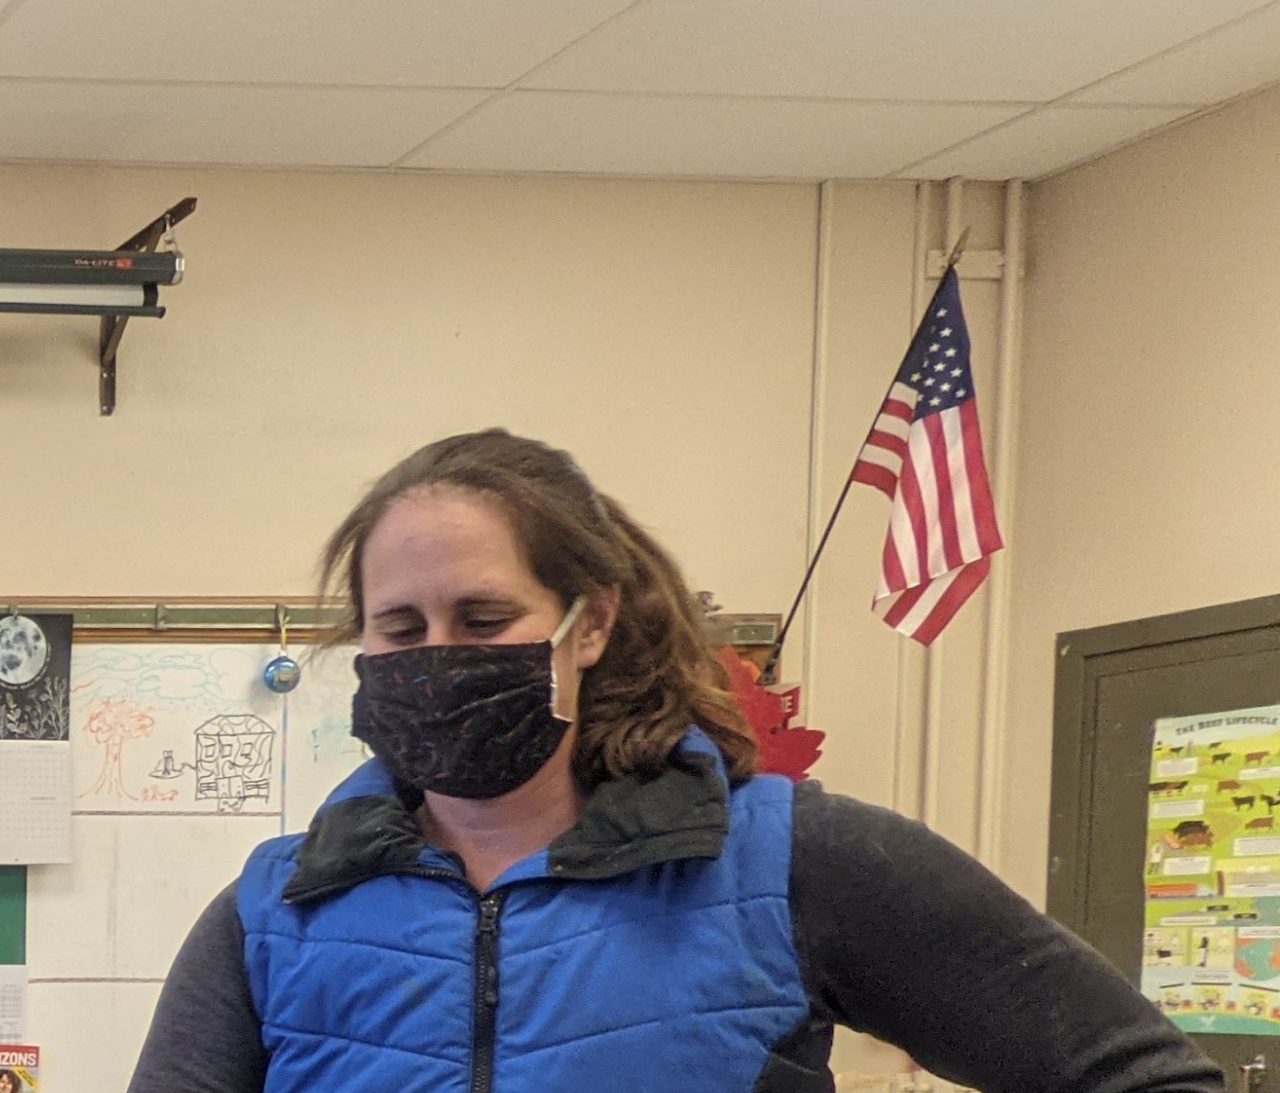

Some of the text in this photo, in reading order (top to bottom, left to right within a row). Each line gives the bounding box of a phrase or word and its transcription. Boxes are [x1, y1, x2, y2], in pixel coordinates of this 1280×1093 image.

[1176, 716, 1278, 735] THE BEEF LIFECYCLE
